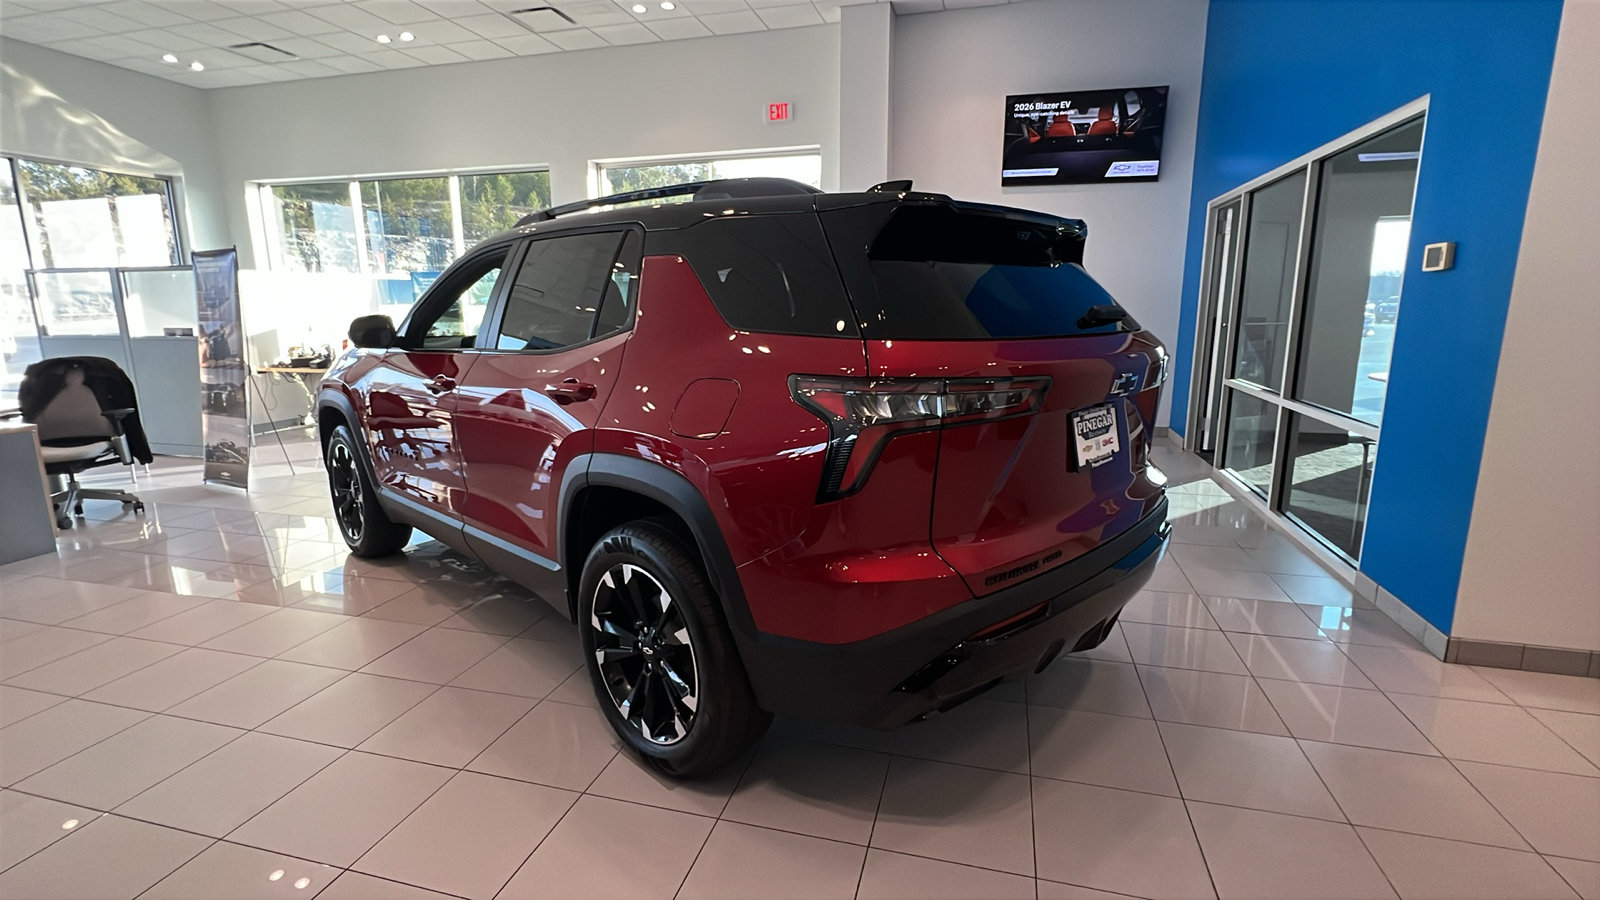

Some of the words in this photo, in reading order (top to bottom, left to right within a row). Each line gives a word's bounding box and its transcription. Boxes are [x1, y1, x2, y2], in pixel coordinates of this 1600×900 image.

[769, 102, 789, 121] EXIT
[1014, 103, 1035, 111] 2026
[1035, 102, 1060, 110] Blazer
[1060, 101, 1071, 109] EV
[1077, 413, 1113, 434] PINEGAR
